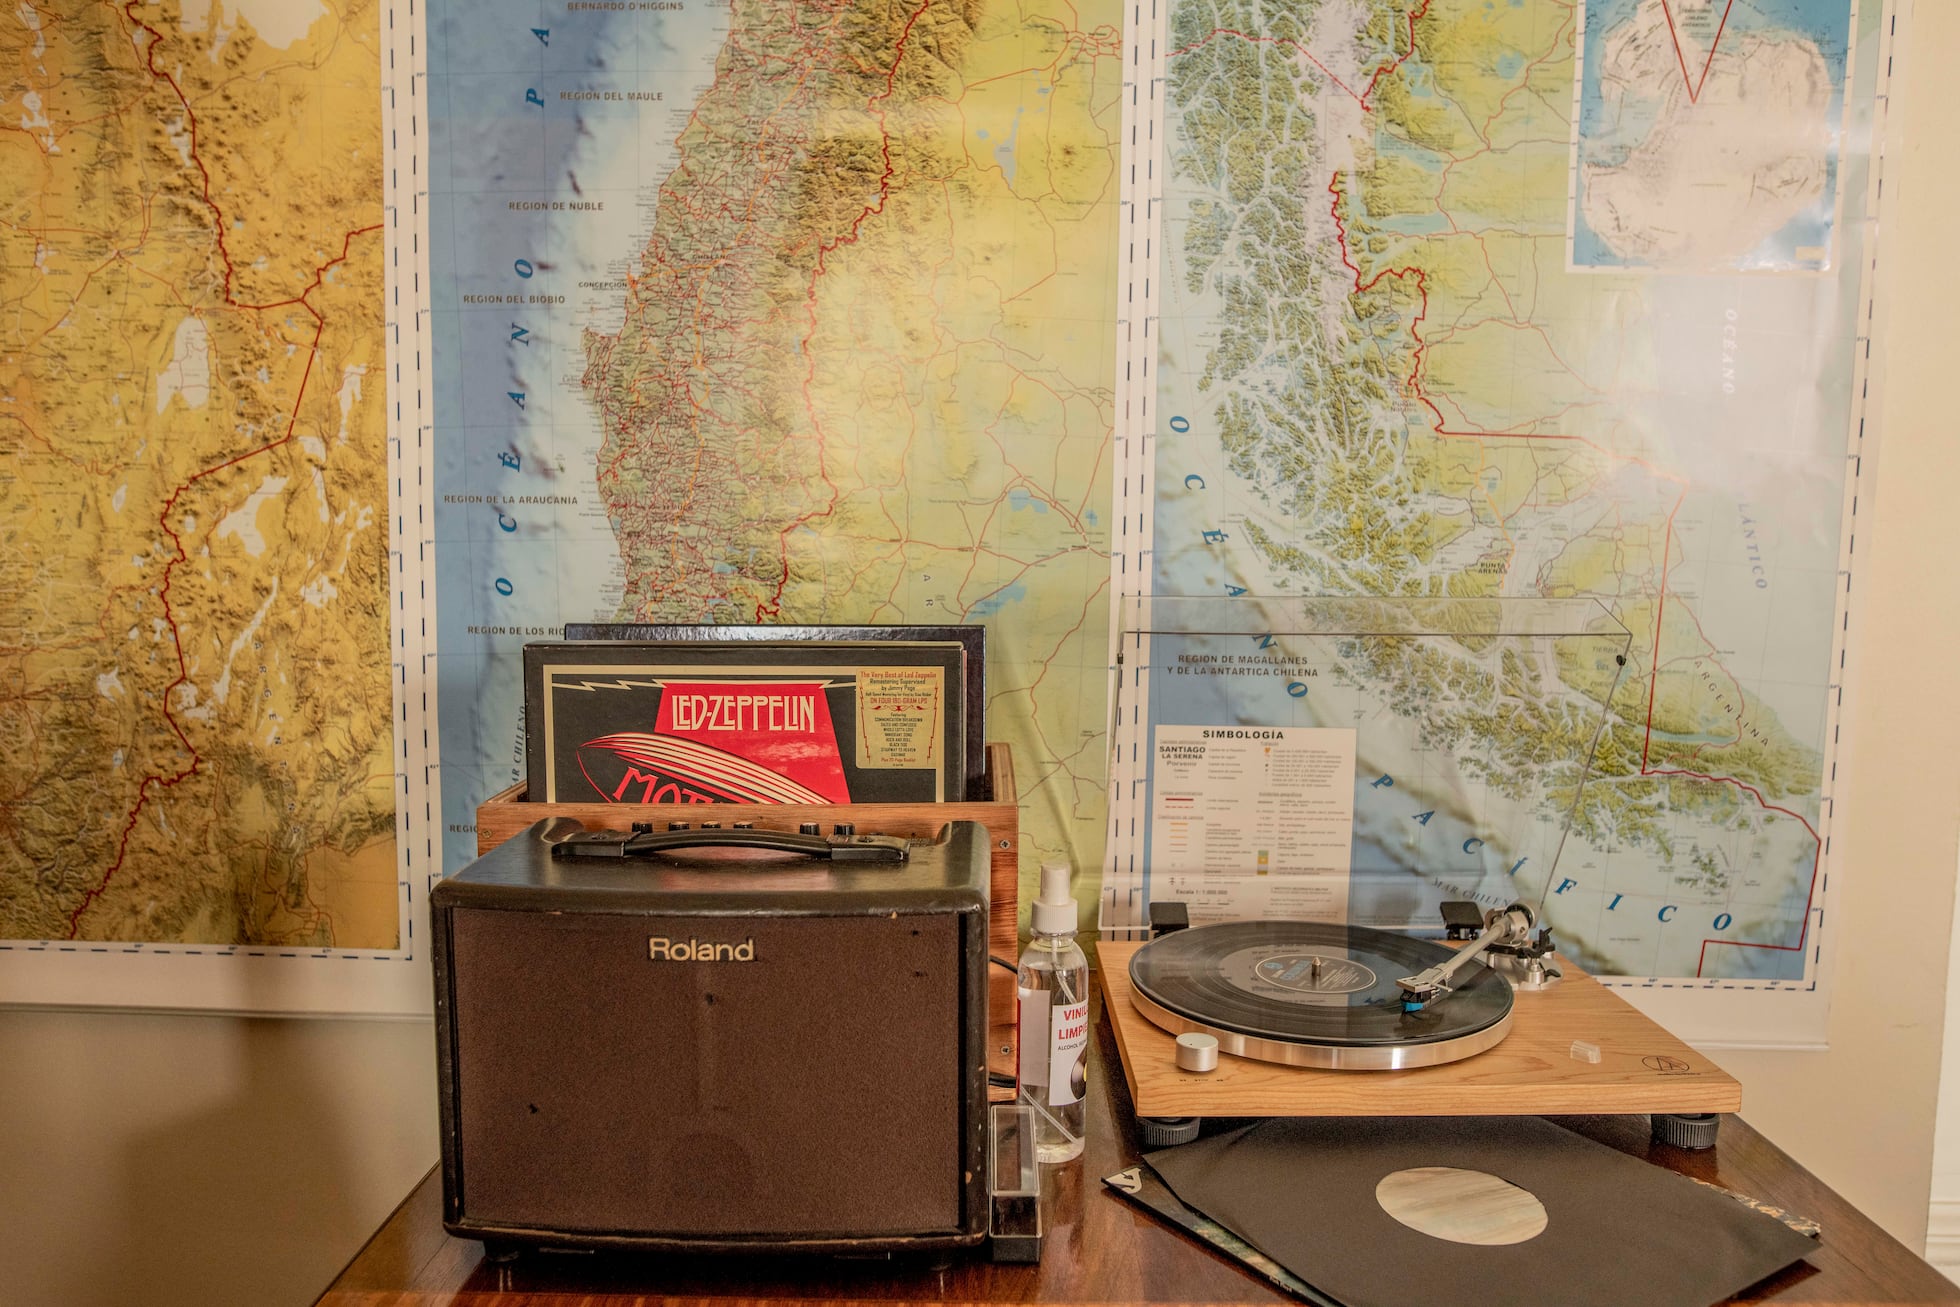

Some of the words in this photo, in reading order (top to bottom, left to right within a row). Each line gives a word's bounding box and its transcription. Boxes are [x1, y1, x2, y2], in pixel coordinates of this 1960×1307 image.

[567, 1, 625, 10] BERNARDO
[560, 92, 600, 101] REGION
[605, 92, 623, 101] DEL
[628, 92, 663, 101] MAULE
[509, 202, 548, 211] REGION
[552, 202, 565, 210] DE
[463, 295, 502, 304] REGION
[506, 295, 525, 304] DEL
[486, 495, 499, 504] DE
[502, 495, 515, 504] LA
[518, 496, 578, 505] ARAUCANIA
[509, 627, 522, 635] DE
[525, 627, 544, 636] LOS
[1178, 655, 1218, 664] REGION
[1221, 656, 1235, 664] DE
[1238, 656, 1308, 665] MAGALLANES
[1177, 667, 1190, 675] DE
[1194, 667, 1207, 675] LA
[1210, 667, 1269, 676] ANTARTICA
[1273, 668, 1318, 677] CHILENA
[1694, 660, 1769, 746] ARGENTINA
[1203, 729, 1284, 739] SIMBOLOGÍA
[648, 937, 756, 961] Roland
